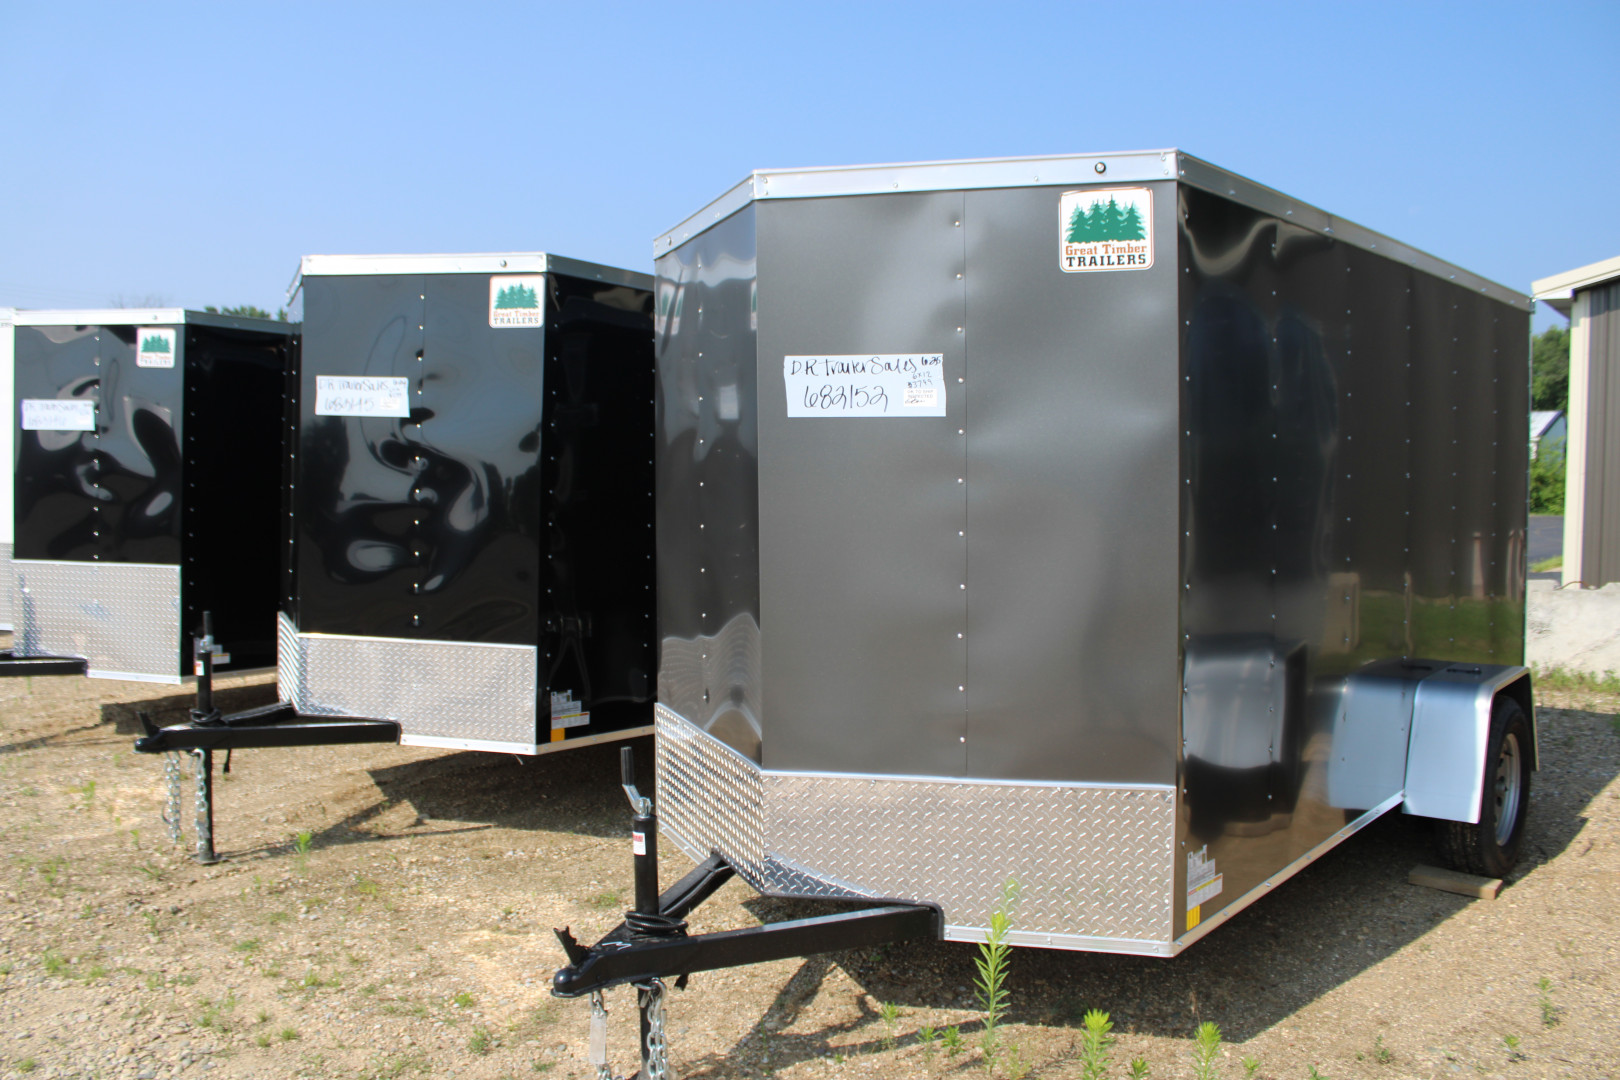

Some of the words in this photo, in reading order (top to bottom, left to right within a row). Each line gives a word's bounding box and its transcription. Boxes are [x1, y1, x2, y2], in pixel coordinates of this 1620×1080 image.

[1065, 245, 1097, 256] Great
[1102, 243, 1147, 254] Timber
[1065, 254, 1146, 267] TRAILERS
[493, 317, 540, 325] TRAILERS
[868, 356, 917, 375] Sales
[804, 384, 889, 413] 682152
